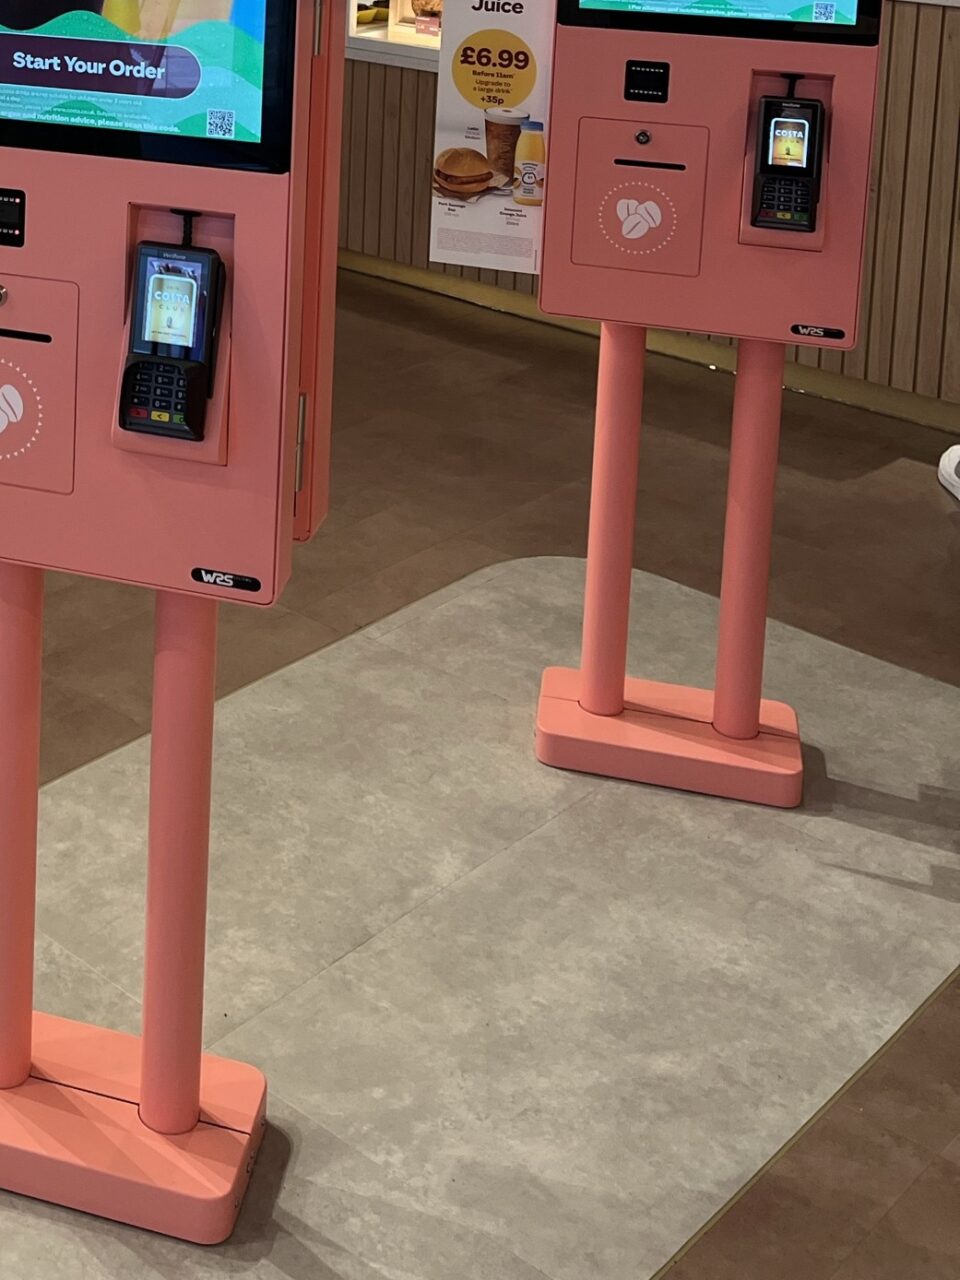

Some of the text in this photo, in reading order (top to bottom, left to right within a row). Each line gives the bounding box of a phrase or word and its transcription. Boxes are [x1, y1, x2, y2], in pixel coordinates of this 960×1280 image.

[12, 51, 165, 80] Start Your Order
[460, 46, 530, 70] £6.99
[481, 96, 504, 106] +35p
[775, 129, 803, 138] COSTA
